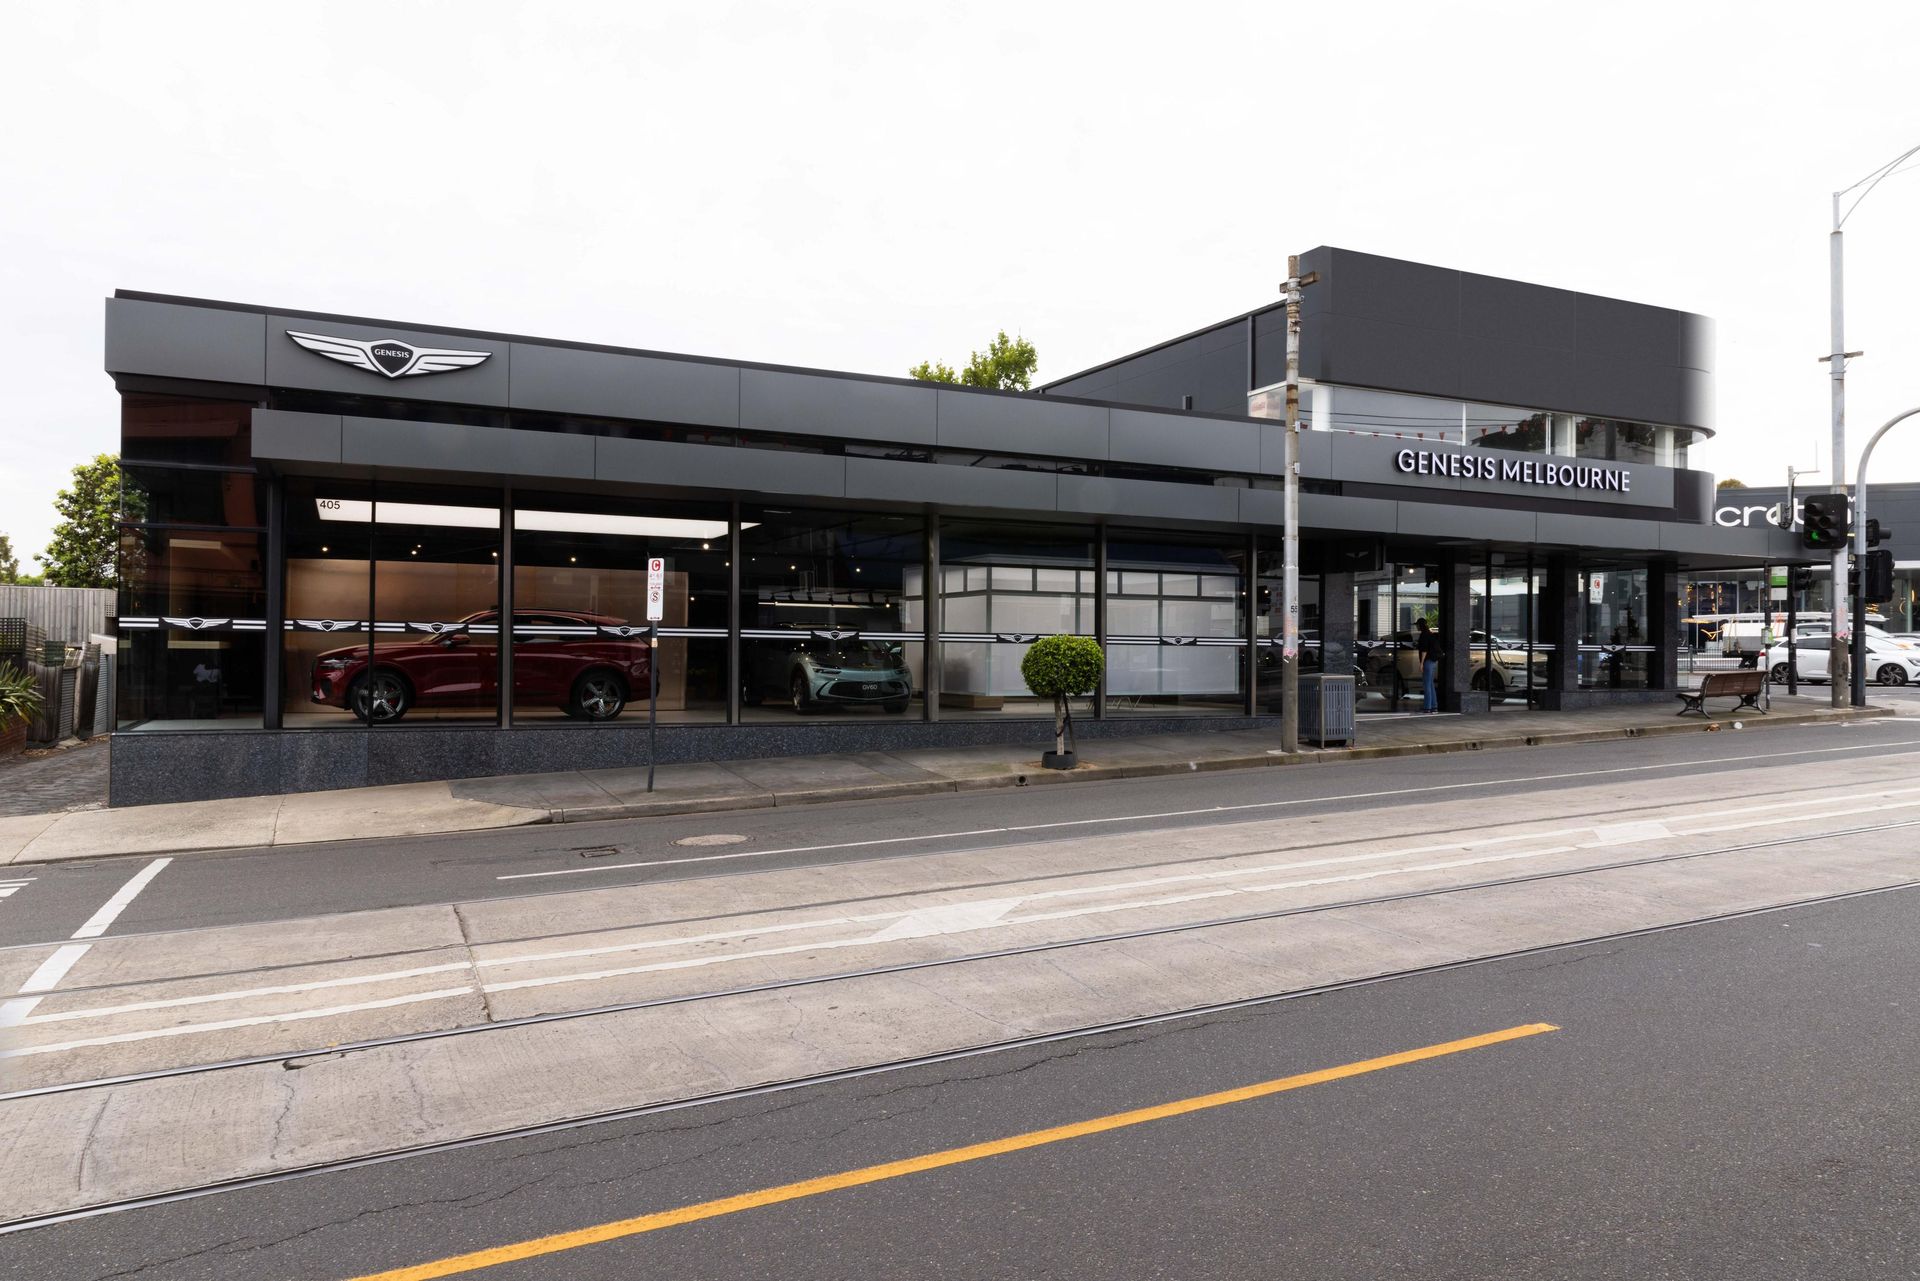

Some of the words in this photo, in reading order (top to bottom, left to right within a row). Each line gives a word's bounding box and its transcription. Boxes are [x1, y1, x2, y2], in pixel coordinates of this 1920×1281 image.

[374, 348, 410, 359] GENESIS
[1397, 449, 1496, 480] GENESIS
[1502, 458, 1631, 492] MELBOURNE
[320, 500, 341, 510] 405
[651, 559, 661, 571] C
